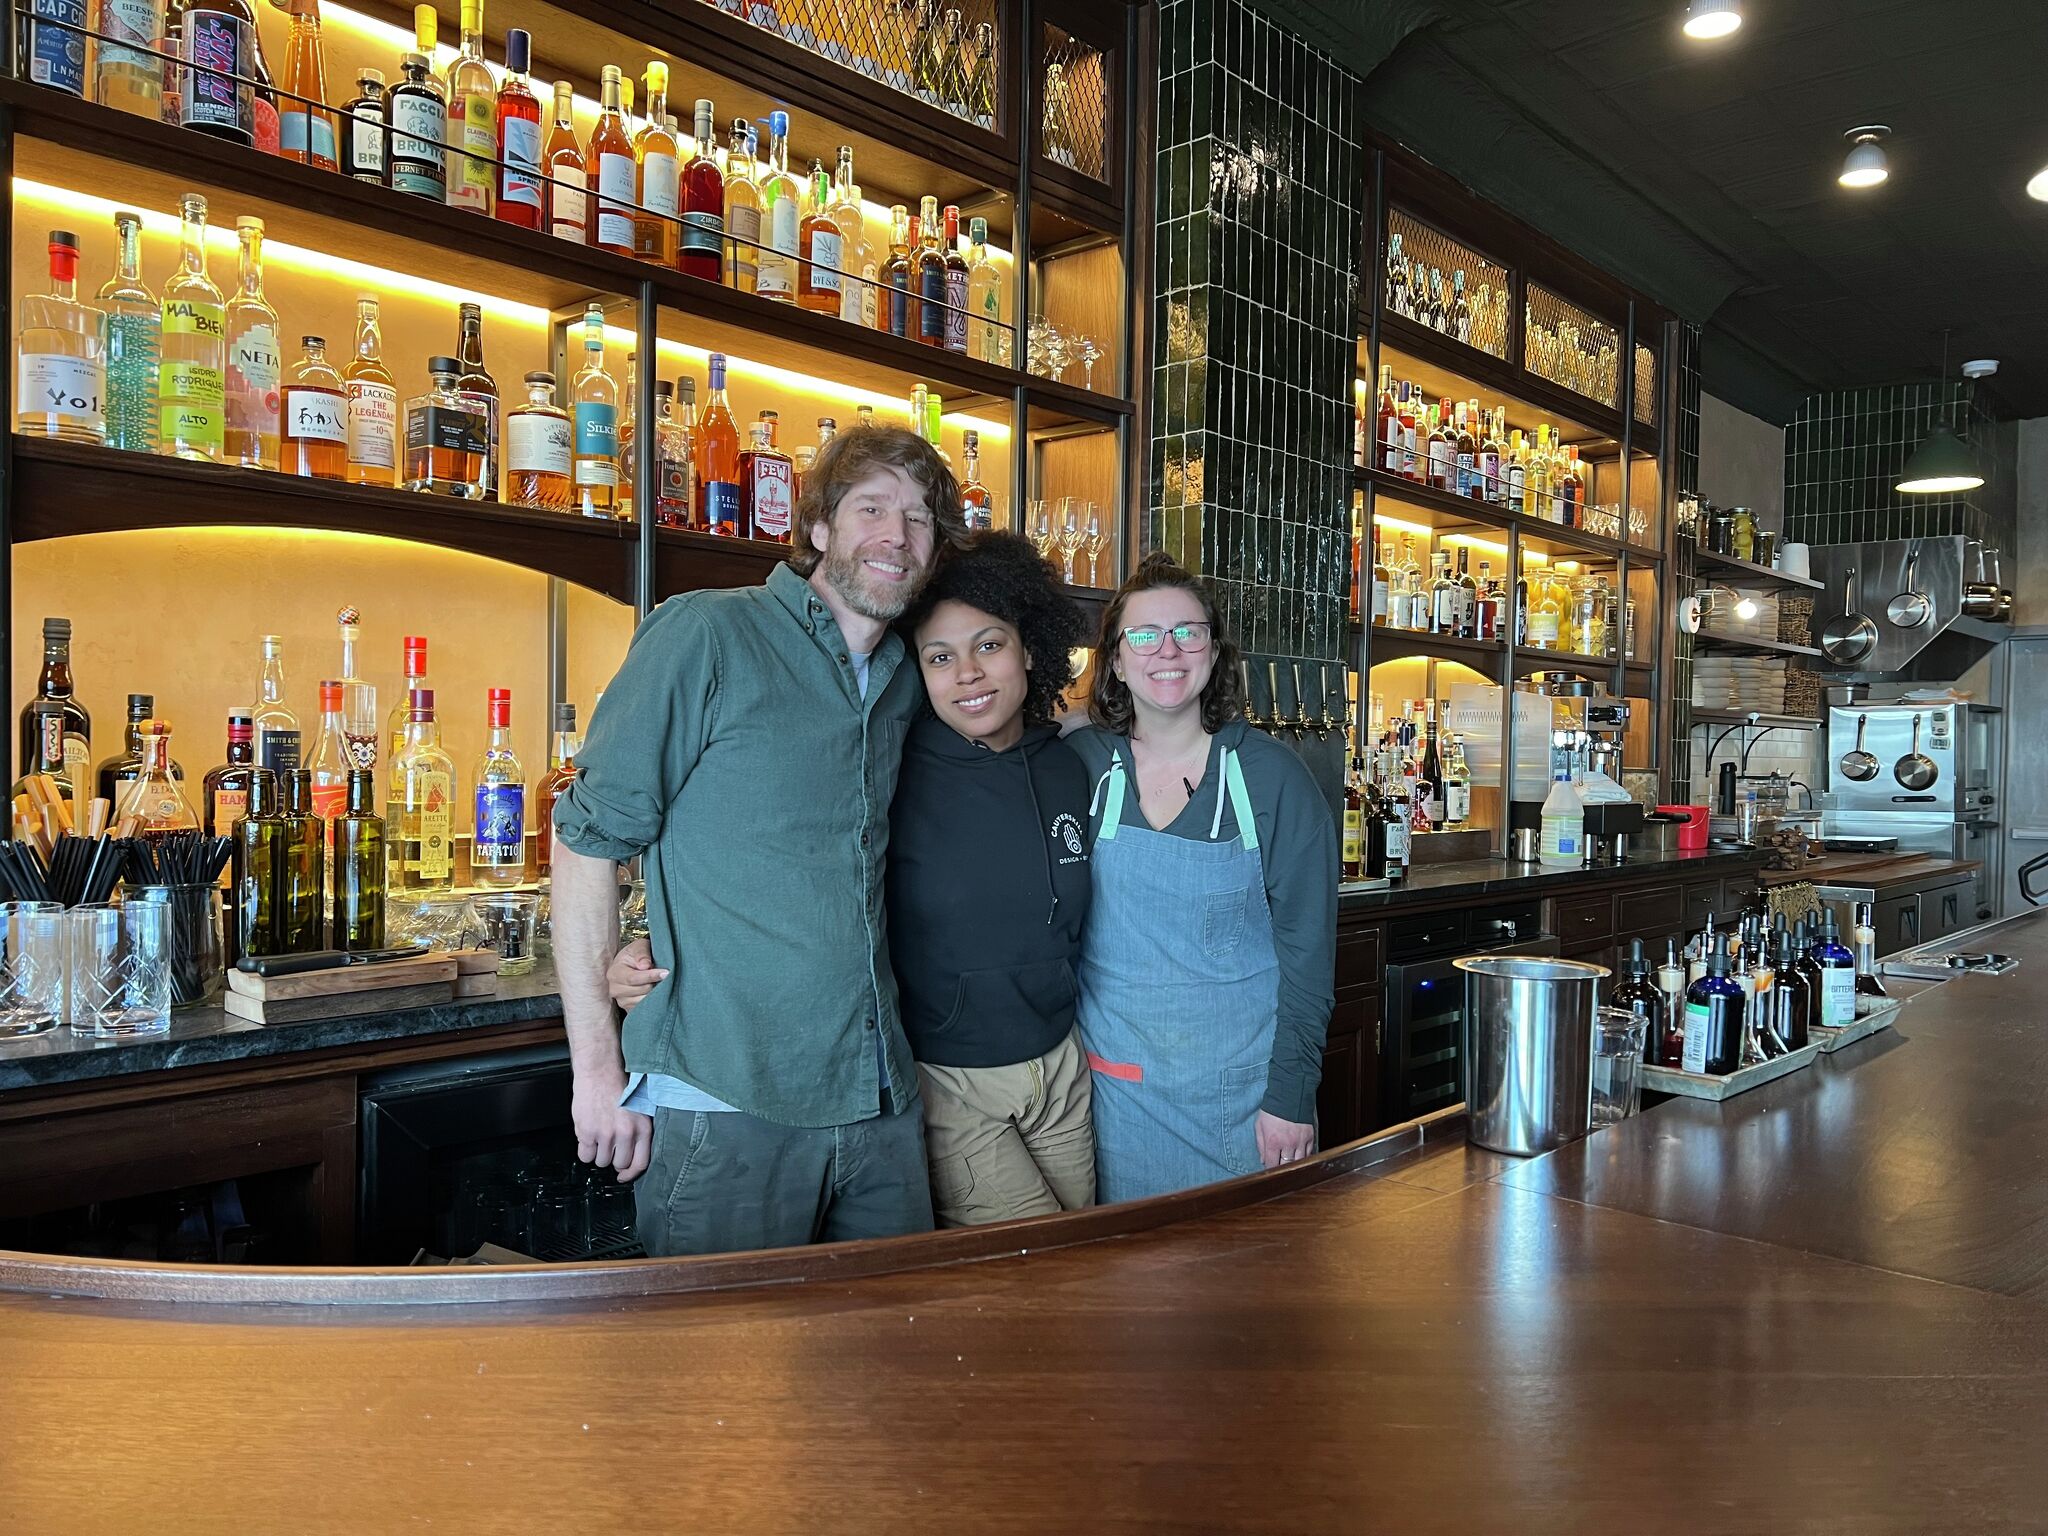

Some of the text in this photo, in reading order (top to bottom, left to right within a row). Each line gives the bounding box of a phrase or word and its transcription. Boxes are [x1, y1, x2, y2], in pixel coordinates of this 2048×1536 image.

[167, 304, 198, 317] MAL
[240, 349, 279, 369] NETA
[189, 367, 217, 378] ISIDRO
[372, 400, 388, 411] THE
[179, 414, 208, 426] ALTO
[760, 462, 787, 480] FEW
